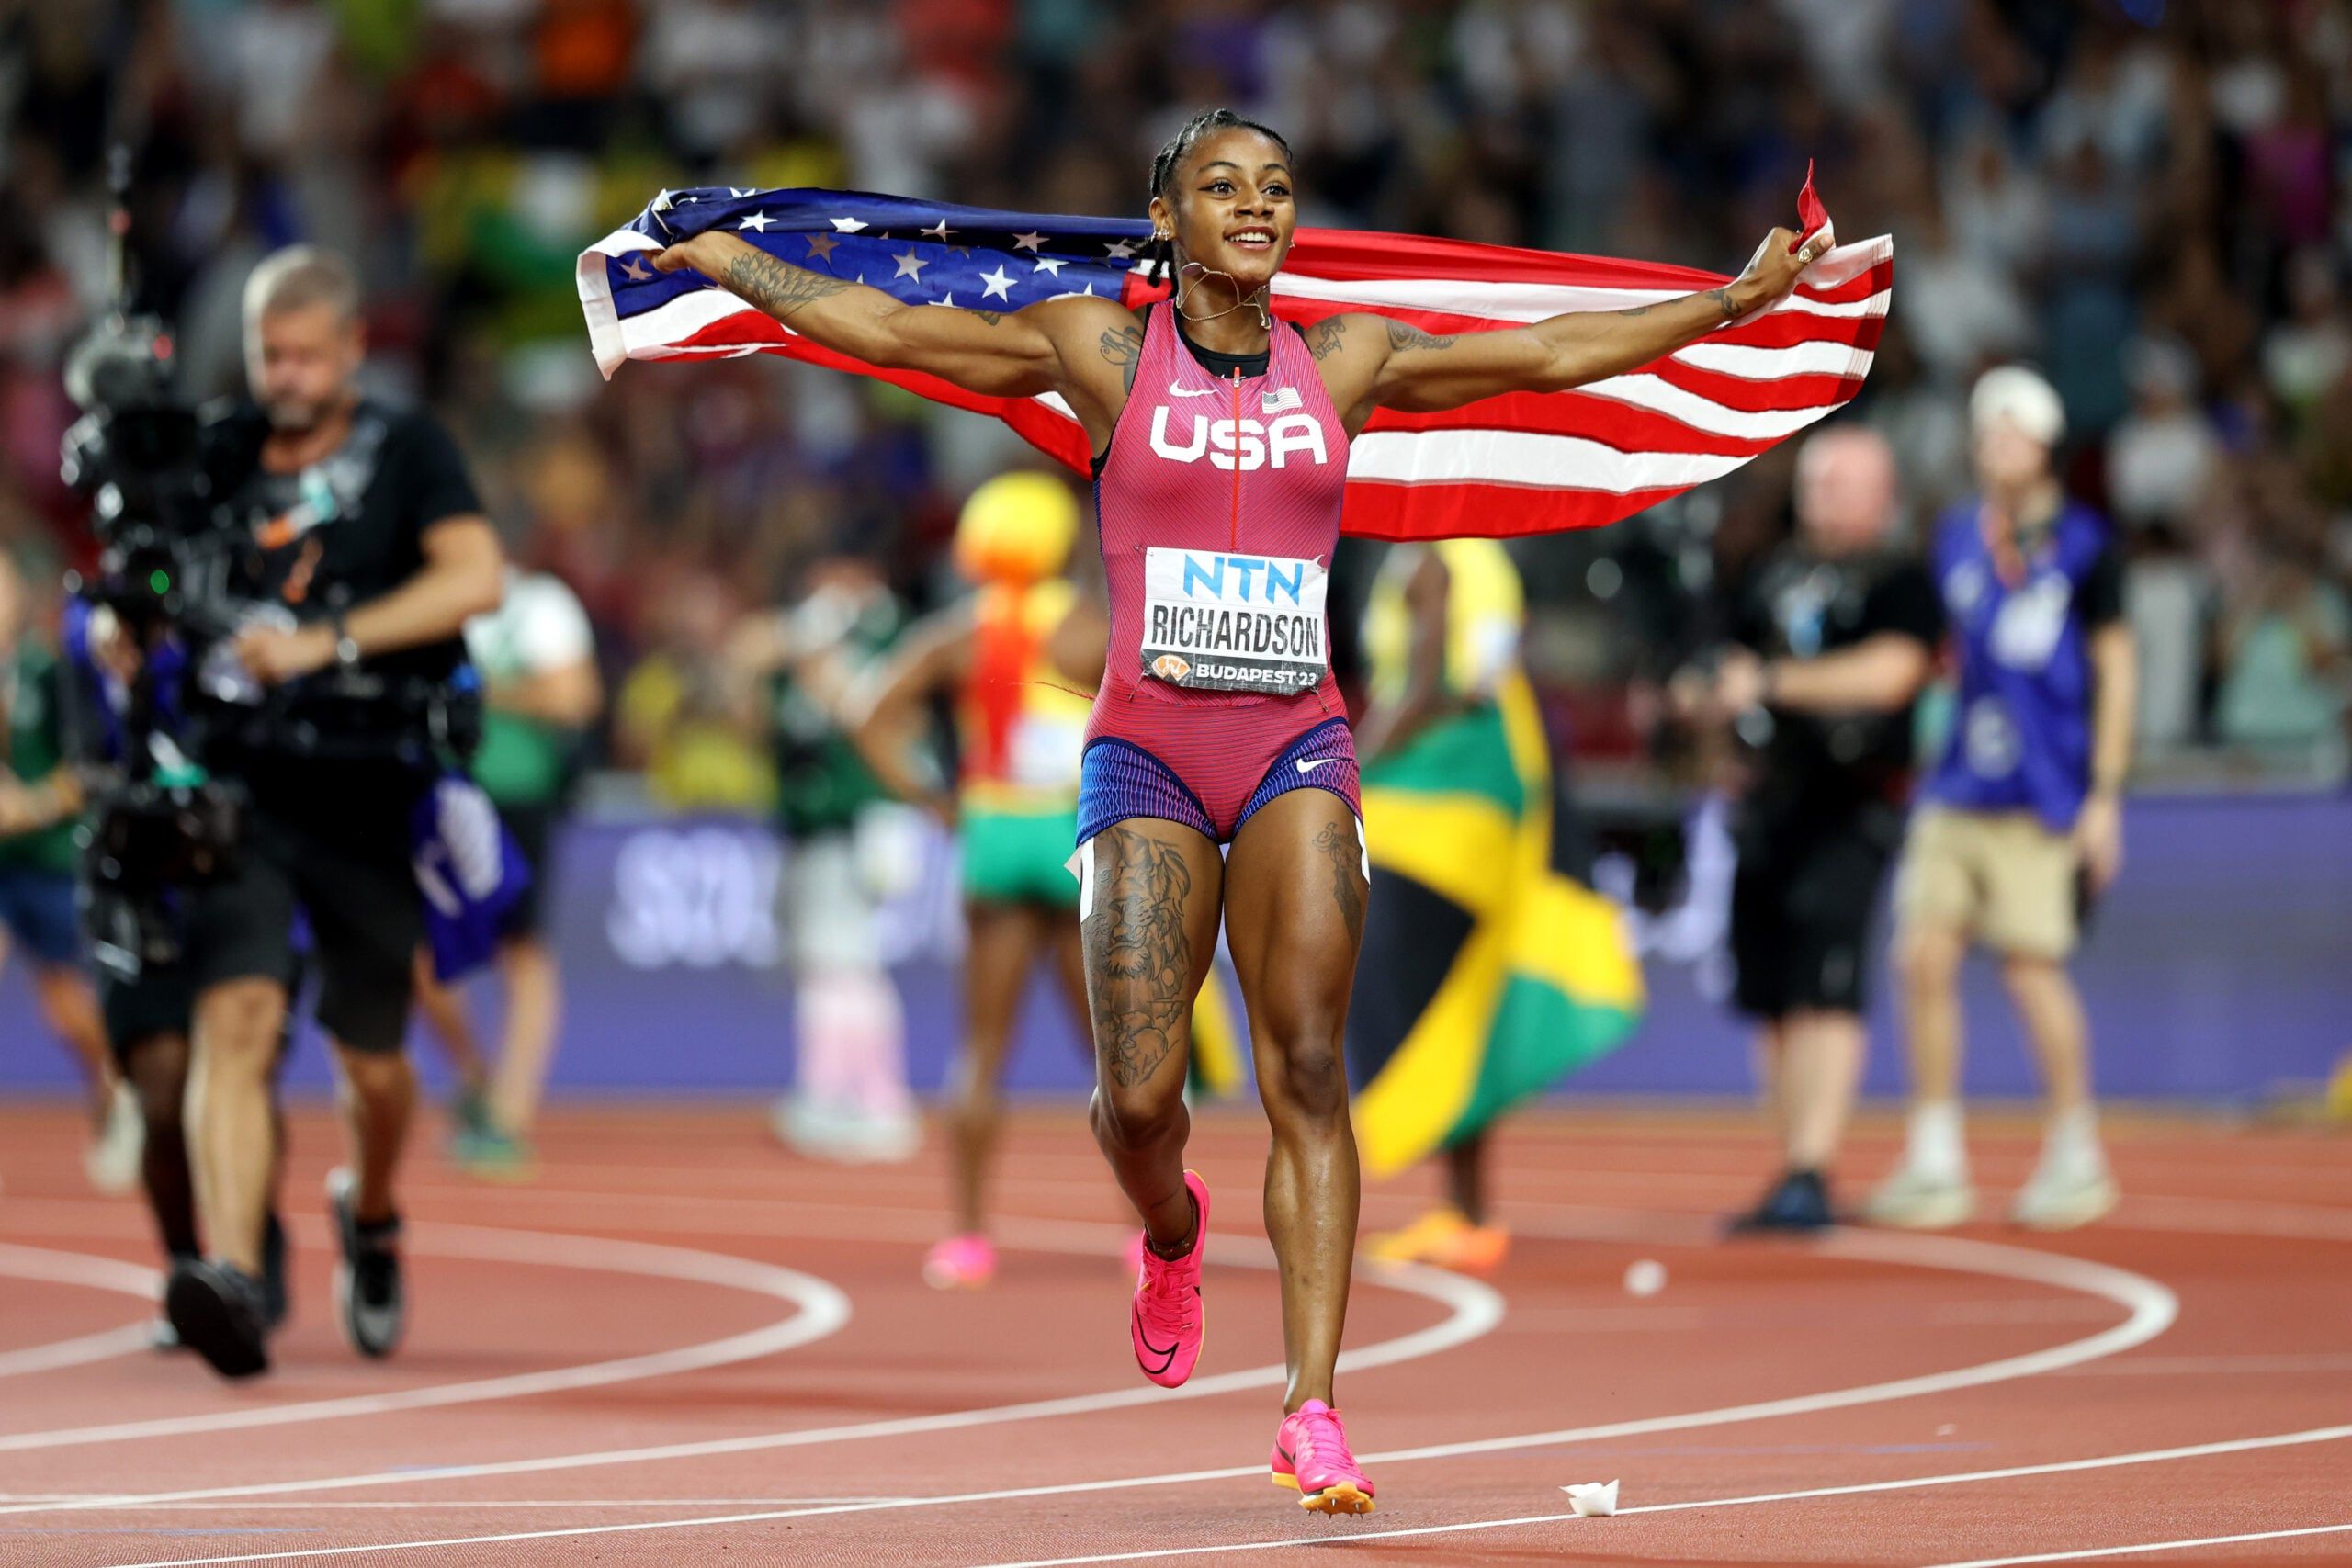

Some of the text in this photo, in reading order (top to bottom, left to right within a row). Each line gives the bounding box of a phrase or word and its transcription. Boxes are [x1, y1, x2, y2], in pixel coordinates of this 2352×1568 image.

[1150, 406, 1328, 470] USA
[1183, 554, 1303, 604] NTN
[1151, 604, 1318, 657] RICHARDSON
[1196, 663, 1317, 686] BUDAPEST 23
